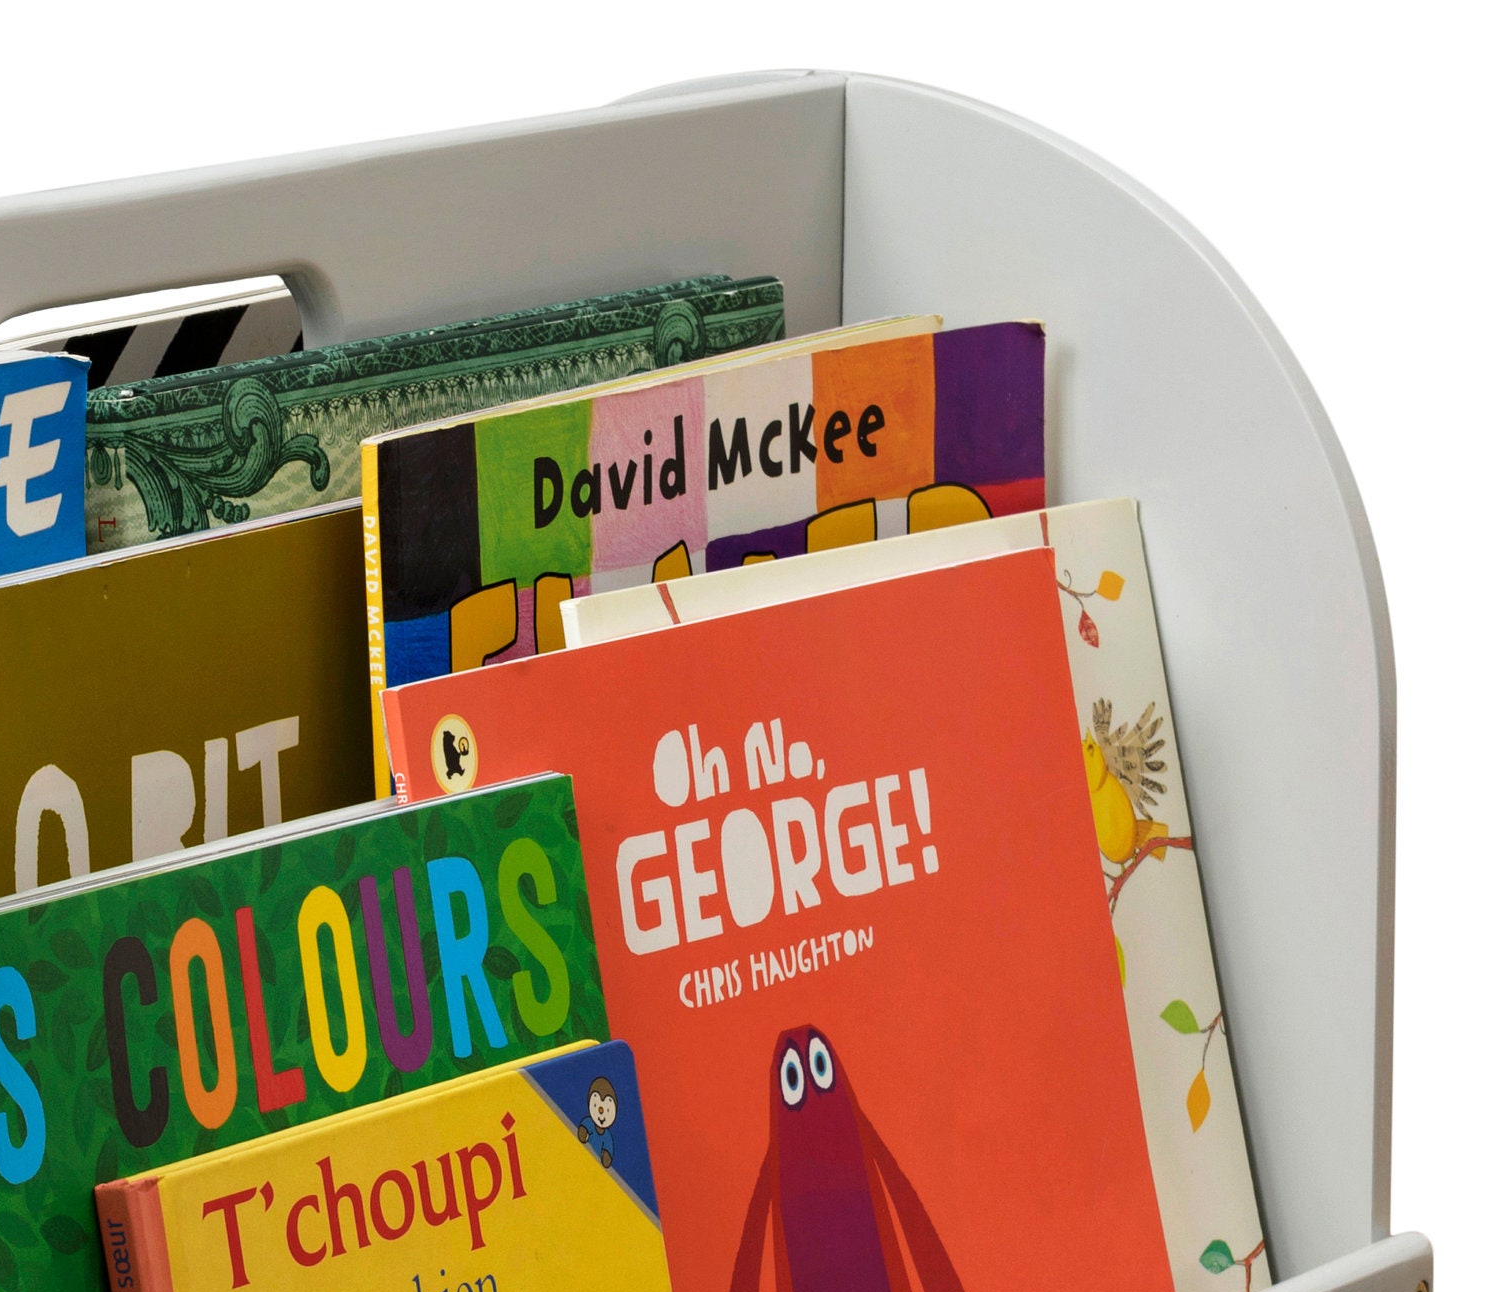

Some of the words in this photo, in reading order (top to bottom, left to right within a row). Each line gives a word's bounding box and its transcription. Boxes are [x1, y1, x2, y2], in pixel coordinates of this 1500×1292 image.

[533, 415, 687, 529] David
[708, 402, 886, 491] McKee
[363, 515, 379, 595] DAVID
[366, 605, 384, 687] MCKEE
[131, 715, 299, 863] BIT
[652, 723, 730, 808] Oh
[744, 717, 826, 793] No,
[615, 767, 940, 957] GEORGE!
[103, 837, 573, 1149] COLOURS
[678, 959, 742, 1009] CHRIS
[750, 926, 874, 991] HAUGHTON
[107, 1218, 135, 1289] sœur
[202, 1111, 528, 1290] T'choupi
